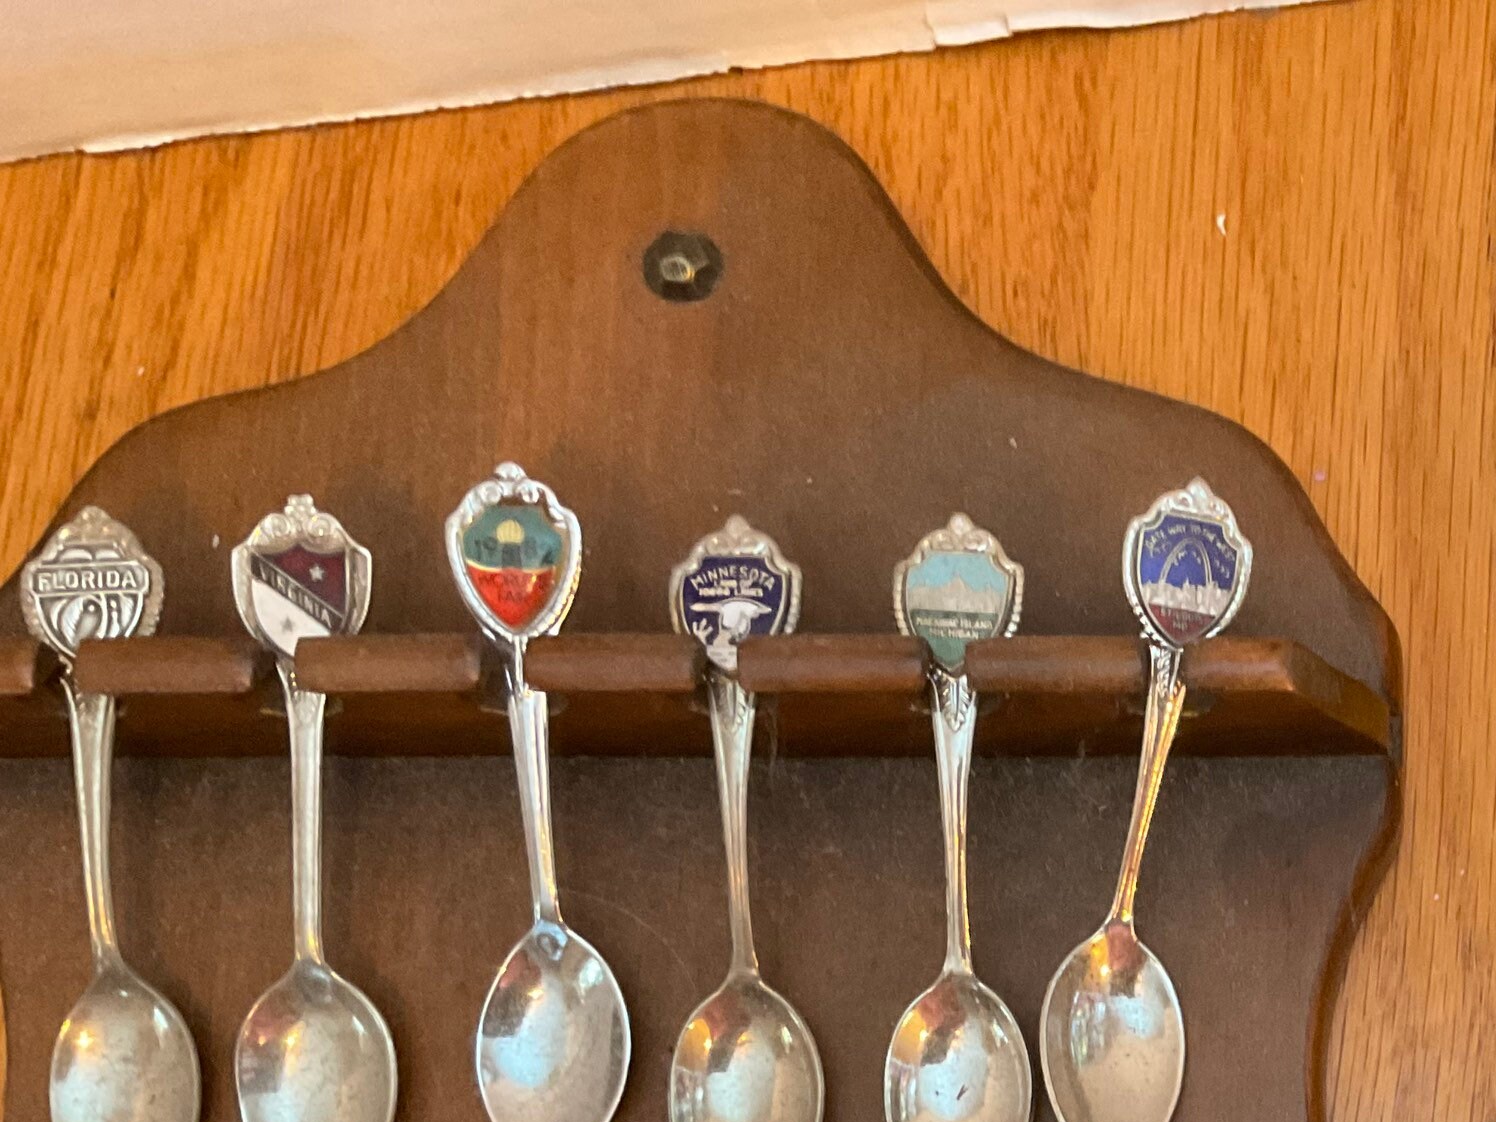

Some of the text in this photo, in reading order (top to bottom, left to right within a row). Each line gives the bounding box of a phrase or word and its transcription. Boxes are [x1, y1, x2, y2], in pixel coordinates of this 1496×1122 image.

[37, 570, 138, 592] FLORIDA
[689, 564, 777, 592] MINNESOTA
[258, 561, 332, 629] VIRGINIA
